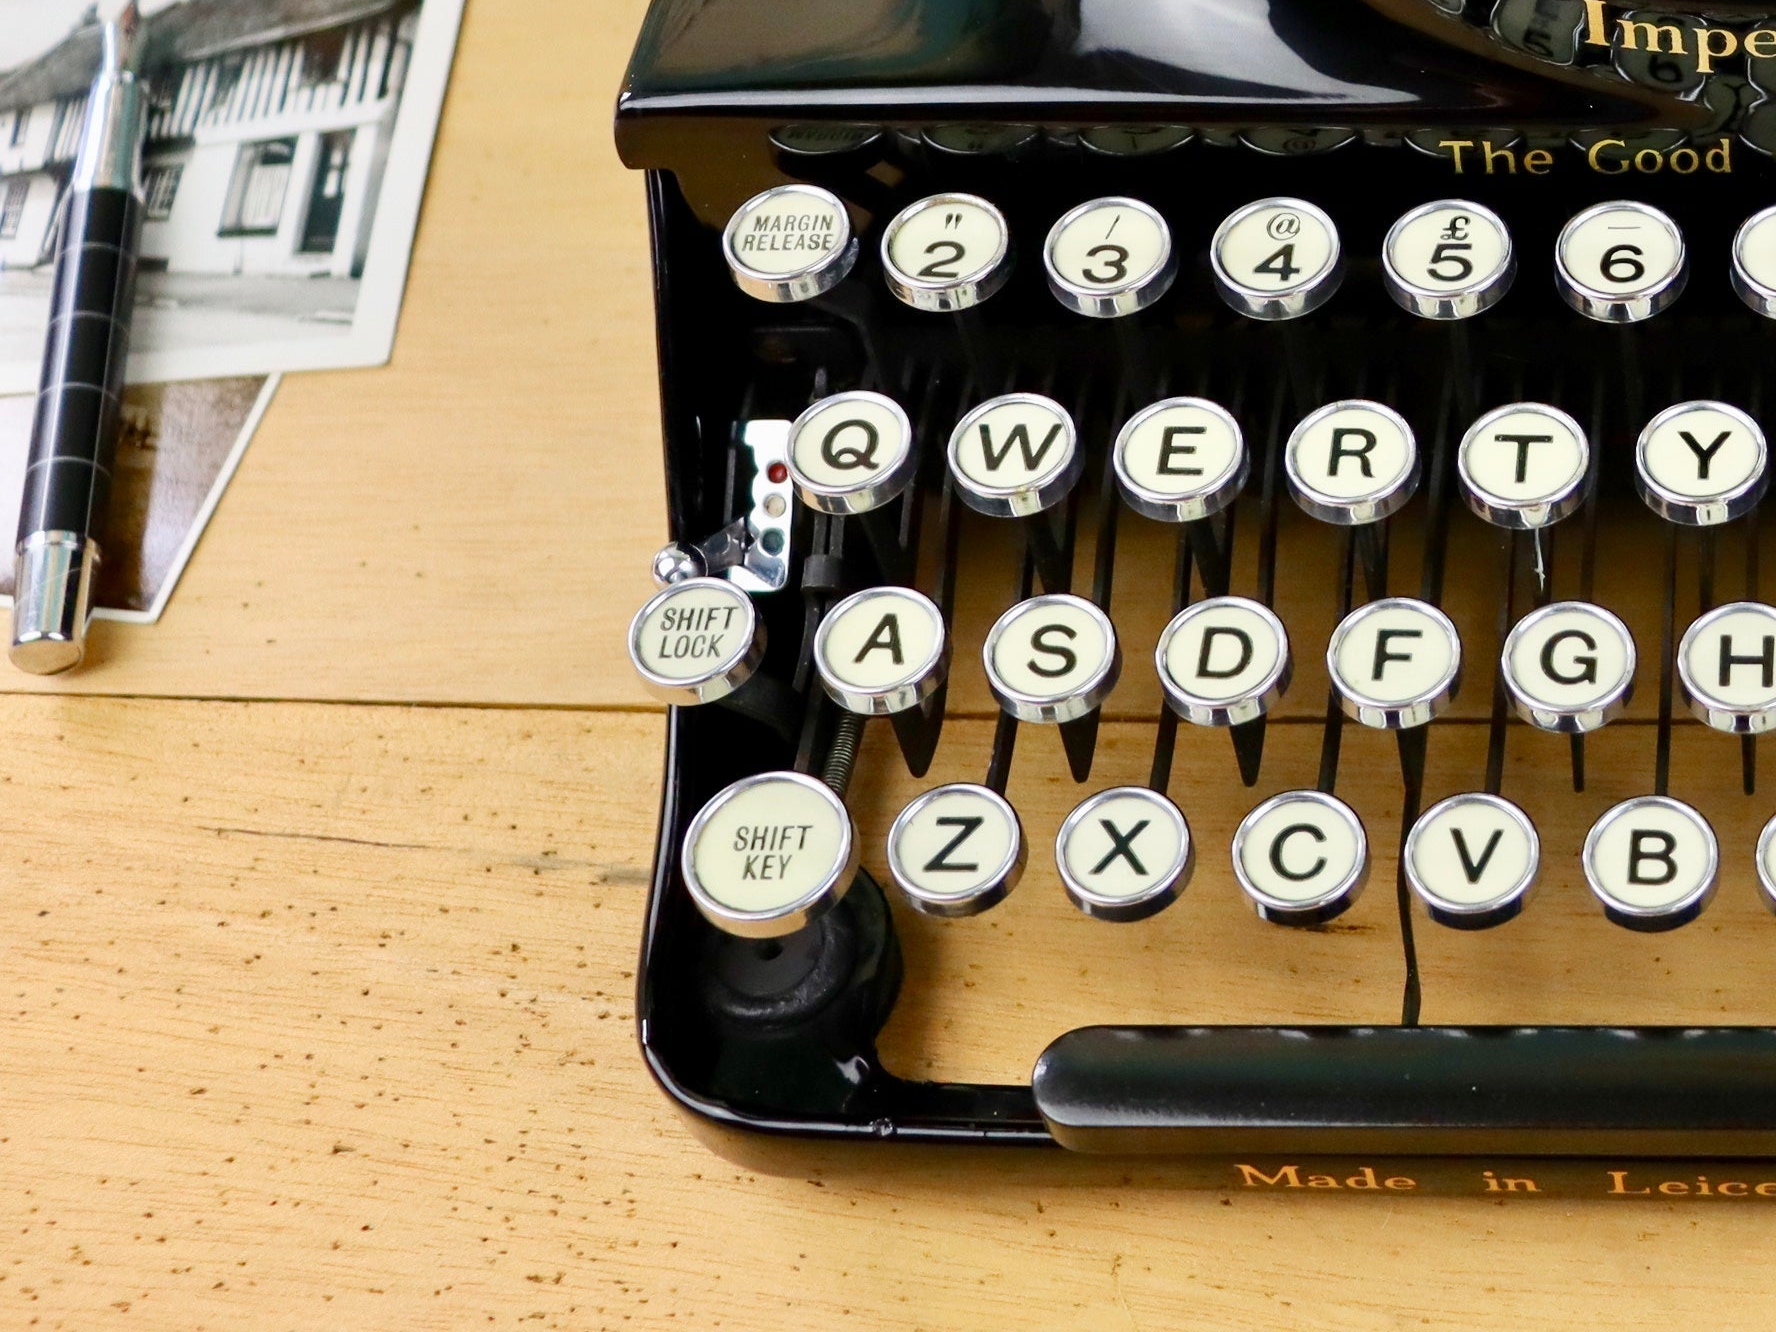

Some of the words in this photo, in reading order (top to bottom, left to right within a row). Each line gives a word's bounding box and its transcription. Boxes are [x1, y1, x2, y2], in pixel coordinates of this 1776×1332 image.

[1439, 140, 1553, 175] The
[1588, 138, 1733, 175] Good
[742, 234, 836, 254] RELEASE
[754, 215, 833, 235] MARGIN
[917, 242, 967, 278] 2
[1081, 244, 1128, 284] 3
[1253, 243, 1301, 282] 4
[1425, 243, 1473, 282] 5
[1599, 244, 1645, 283] 6
[820, 418, 879, 470] Q
[979, 422, 1062, 470] W
[1157, 427, 1206, 475] E
[1328, 428, 1376, 478] R
[1495, 435, 1553, 483] T
[1676, 430, 1731, 480] Y
[658, 603, 737, 631] SHIFT
[855, 614, 904, 664] A
[659, 635, 723, 658] LOCK
[1027, 624, 1076, 678] S
[1196, 627, 1252, 679] D
[1372, 629, 1422, 680] F
[1540, 630, 1597, 685] G
[1719, 635, 1774, 687] H
[735, 826, 812, 850] SHIFT
[923, 817, 983, 872] Z
[1088, 818, 1151, 875] X
[1268, 822, 1327, 878] C
[1450, 828, 1503, 883] V
[1628, 830, 1677, 885] B
[743, 855, 791, 879] KEY
[1233, 1164, 1417, 1192] Made
[1484, 1171, 1540, 1193] in
